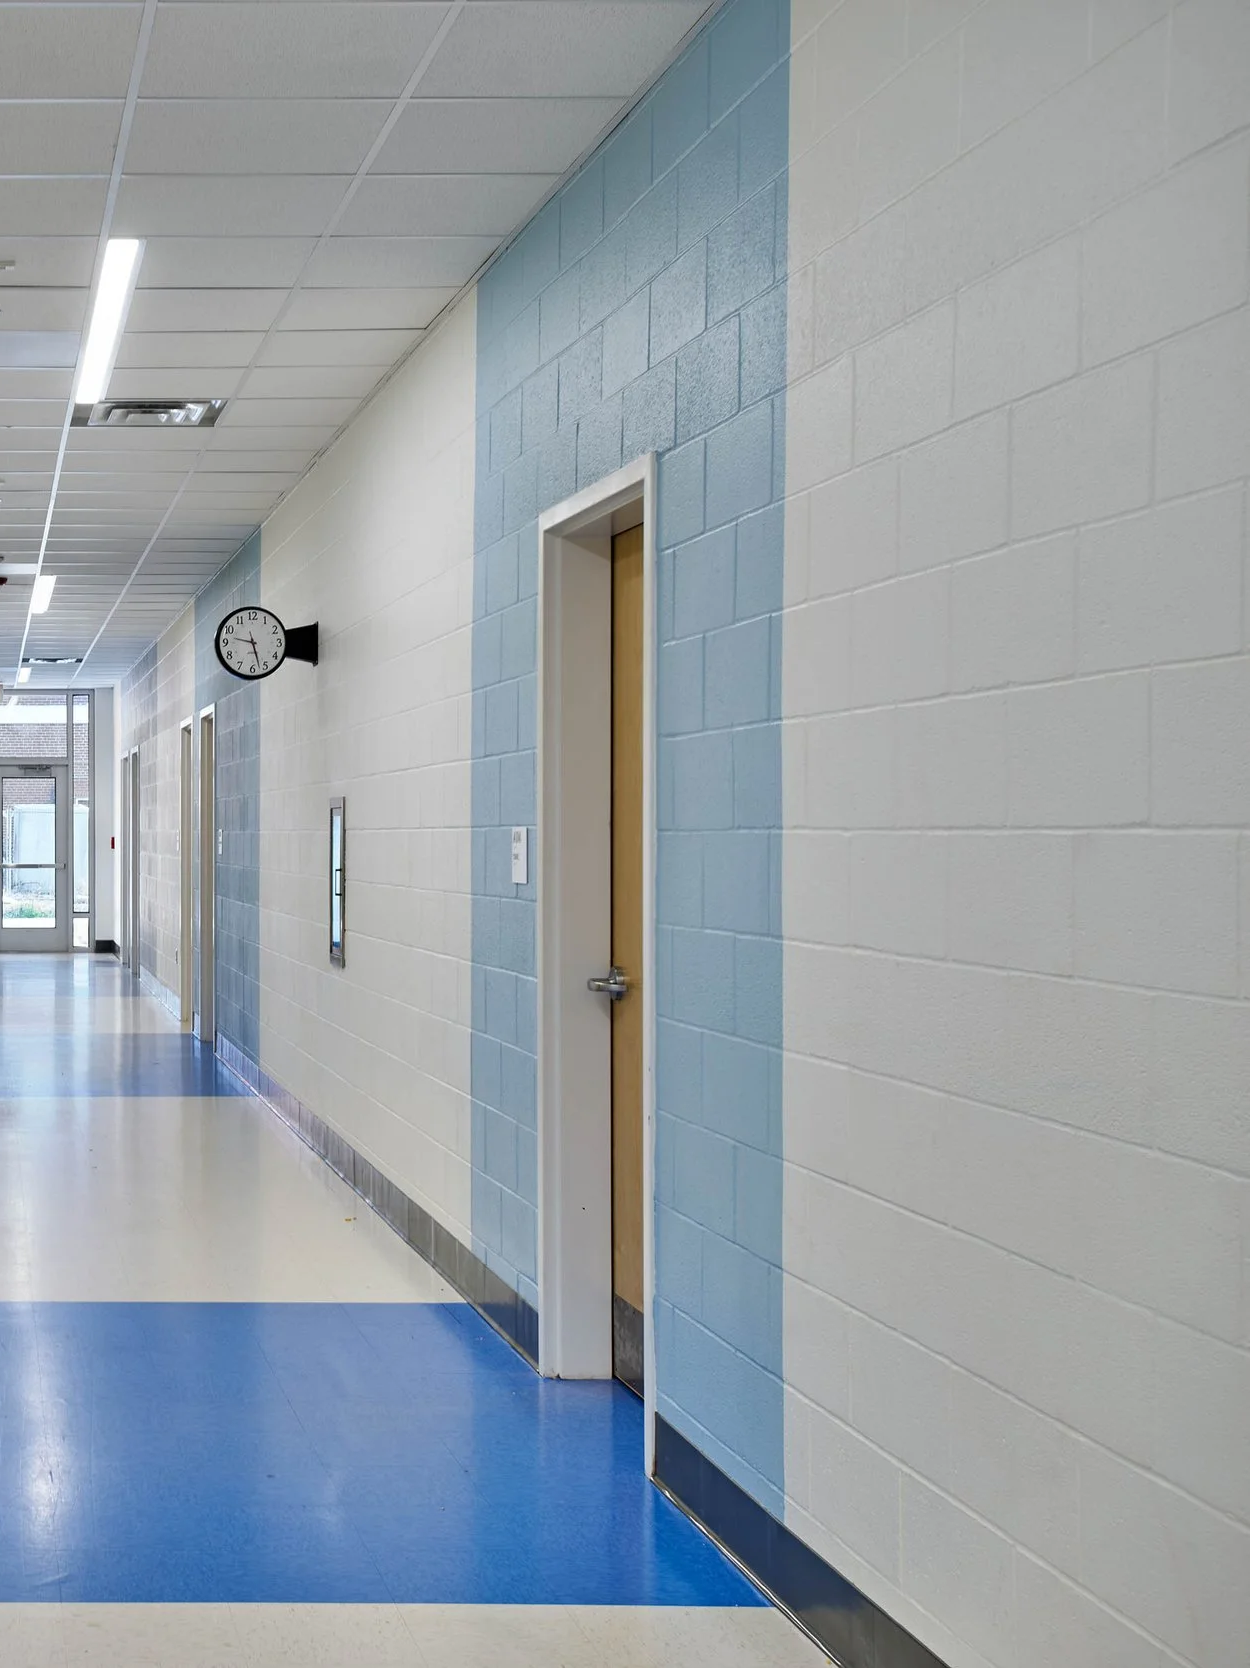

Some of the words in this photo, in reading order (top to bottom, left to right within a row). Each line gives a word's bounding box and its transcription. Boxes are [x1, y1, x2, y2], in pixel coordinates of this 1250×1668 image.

[236, 616, 243, 624] 11
[248, 611, 258, 620] 12
[225, 625, 234, 634] 10
[272, 625, 278, 634] 2
[222, 638, 228, 647] 9
[276, 638, 282, 647] 3
[226, 651, 232, 660] 8
[272, 651, 278, 660] 4
[236, 661, 243, 670] 7
[250, 664, 256, 673] 6
[262, 661, 268, 670] 5
